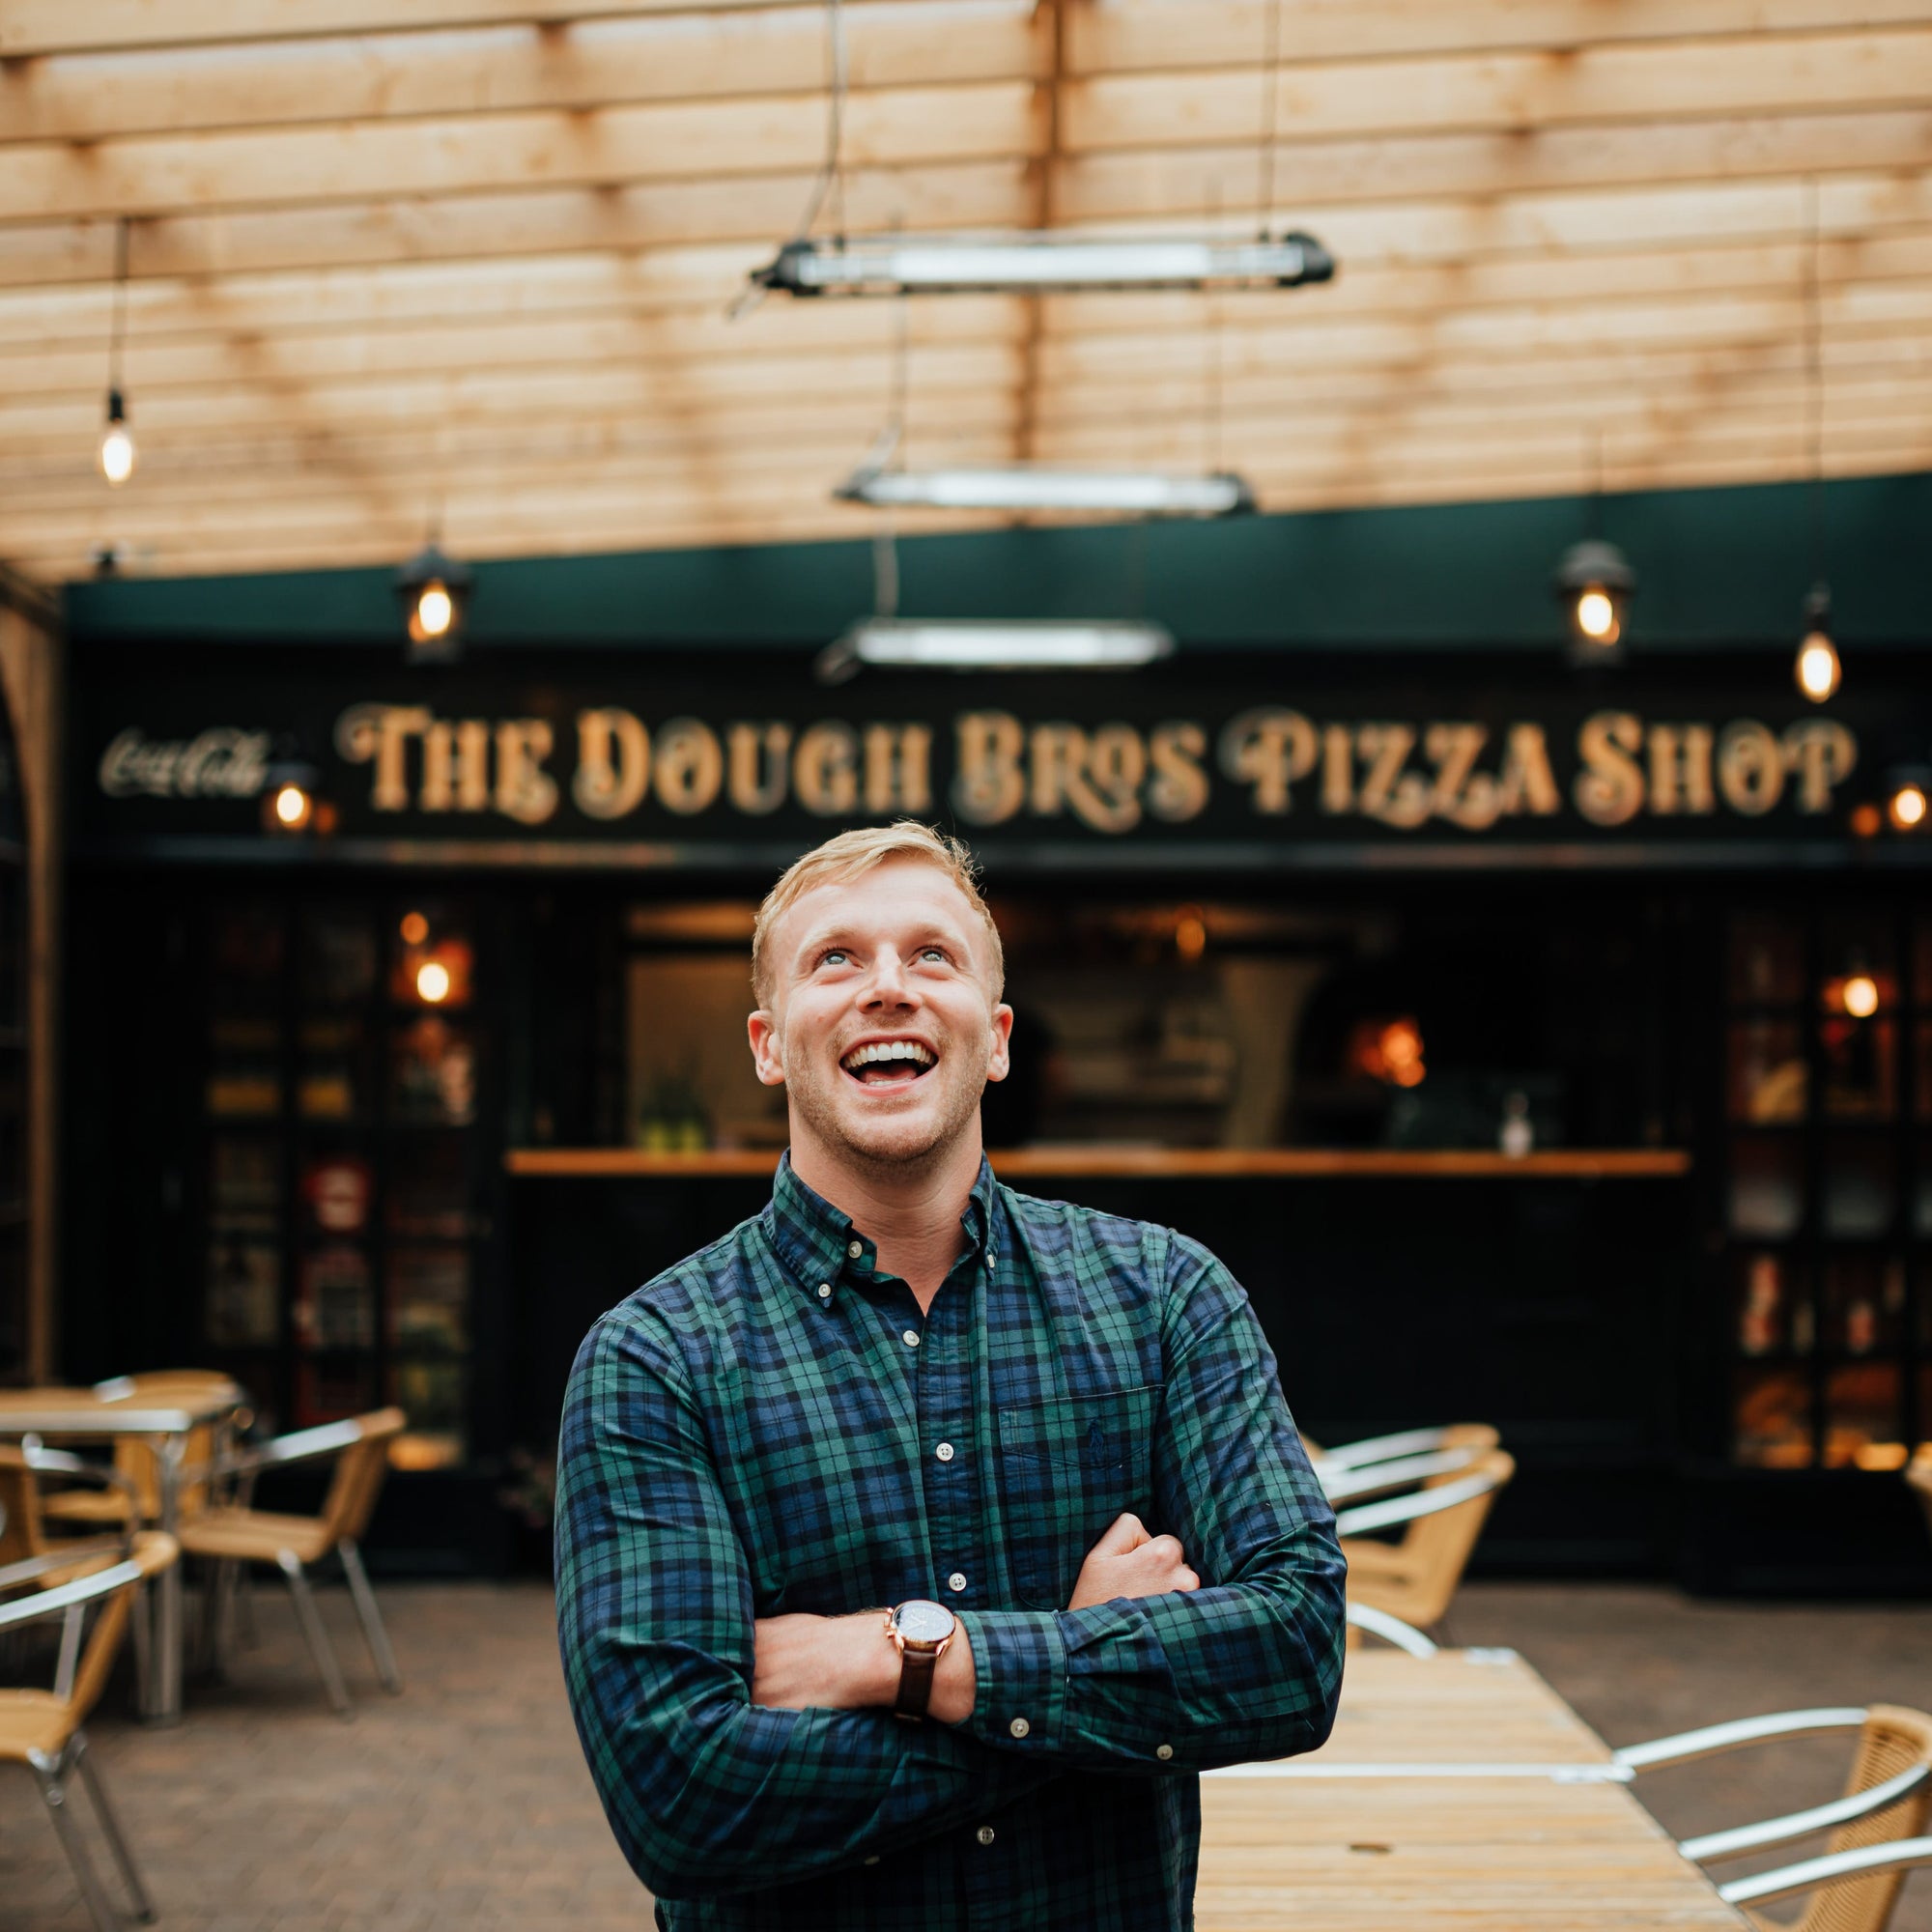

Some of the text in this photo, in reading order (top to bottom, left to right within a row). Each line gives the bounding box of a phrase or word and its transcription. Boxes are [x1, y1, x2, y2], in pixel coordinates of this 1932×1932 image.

[334, 703, 1858, 835] THE DOUGH BROS PIZZA SHOP
